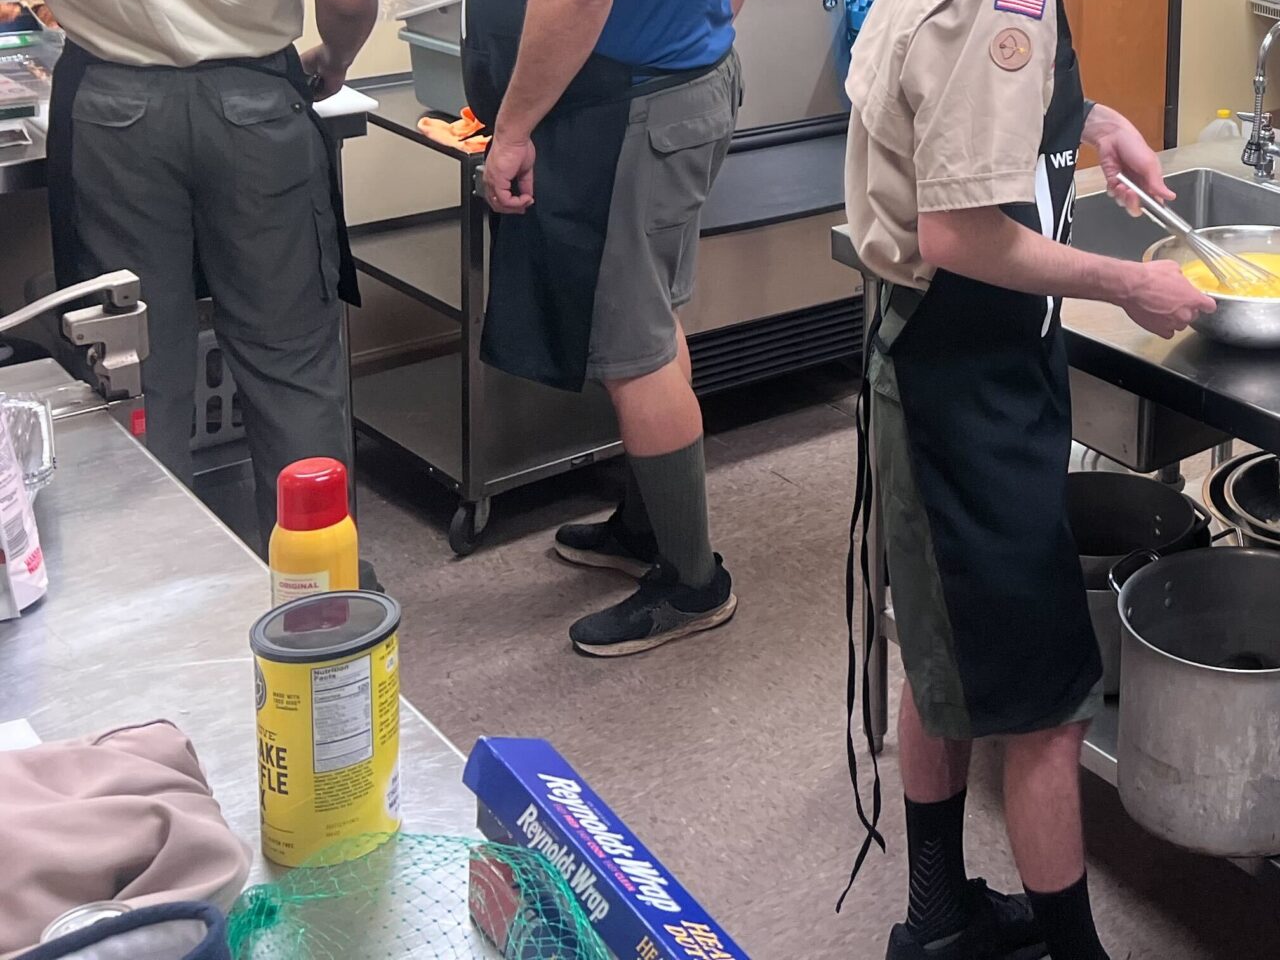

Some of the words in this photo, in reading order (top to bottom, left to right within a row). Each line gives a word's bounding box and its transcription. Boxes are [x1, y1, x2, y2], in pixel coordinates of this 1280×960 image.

[1050, 150, 1074, 169] WE
[279, 581, 320, 590] ORIGINAL
[314, 664, 349, 675] Nutrition
[536, 773, 635, 858] Reynolds
[612, 857, 682, 913] Wrap
[516, 802, 576, 880] Reynolds
[569, 862, 610, 922] Wrap
[680, 920, 736, 960] HEA
